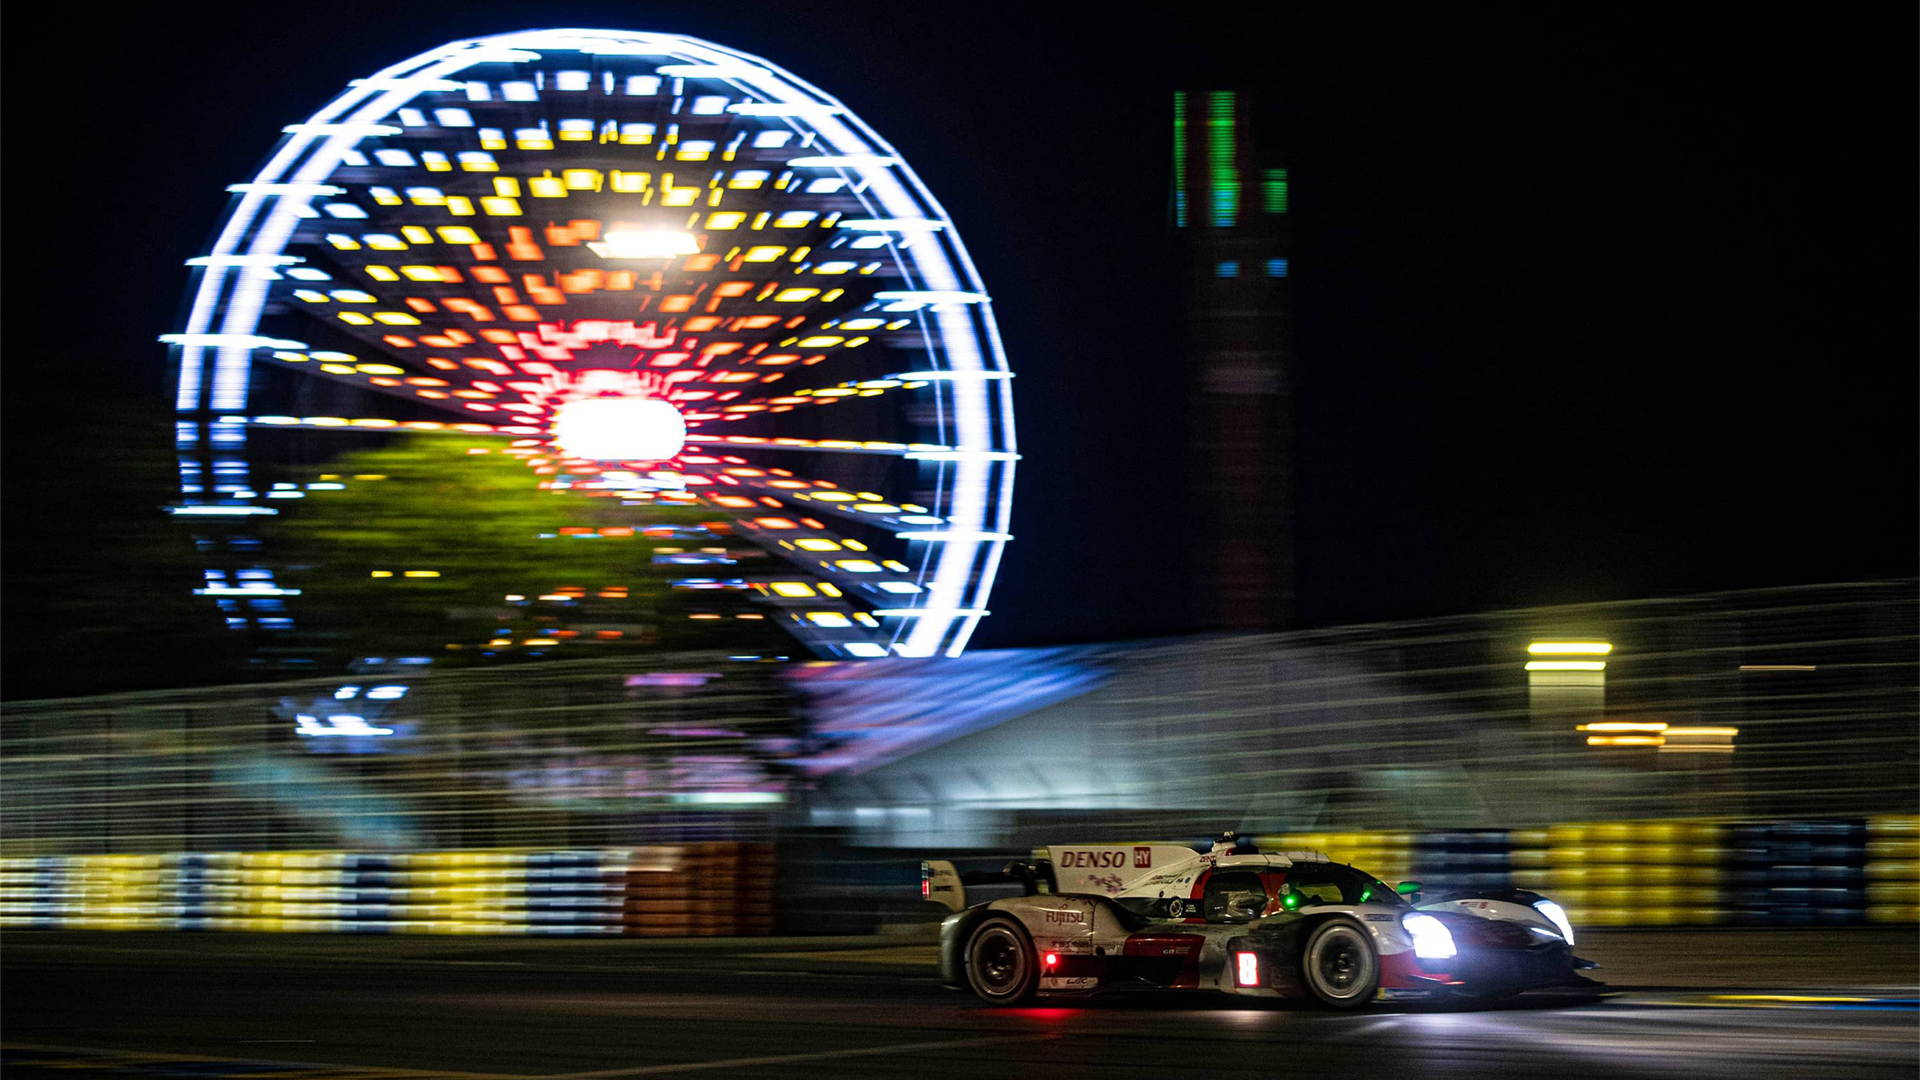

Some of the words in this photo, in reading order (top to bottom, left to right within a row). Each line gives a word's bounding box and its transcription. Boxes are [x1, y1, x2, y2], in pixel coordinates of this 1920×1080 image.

[1061, 851, 1126, 868] DENSO
[1135, 850, 1150, 866] HY
[1046, 911, 1084, 926] FUJITSU
[1238, 953, 1257, 985] 8
